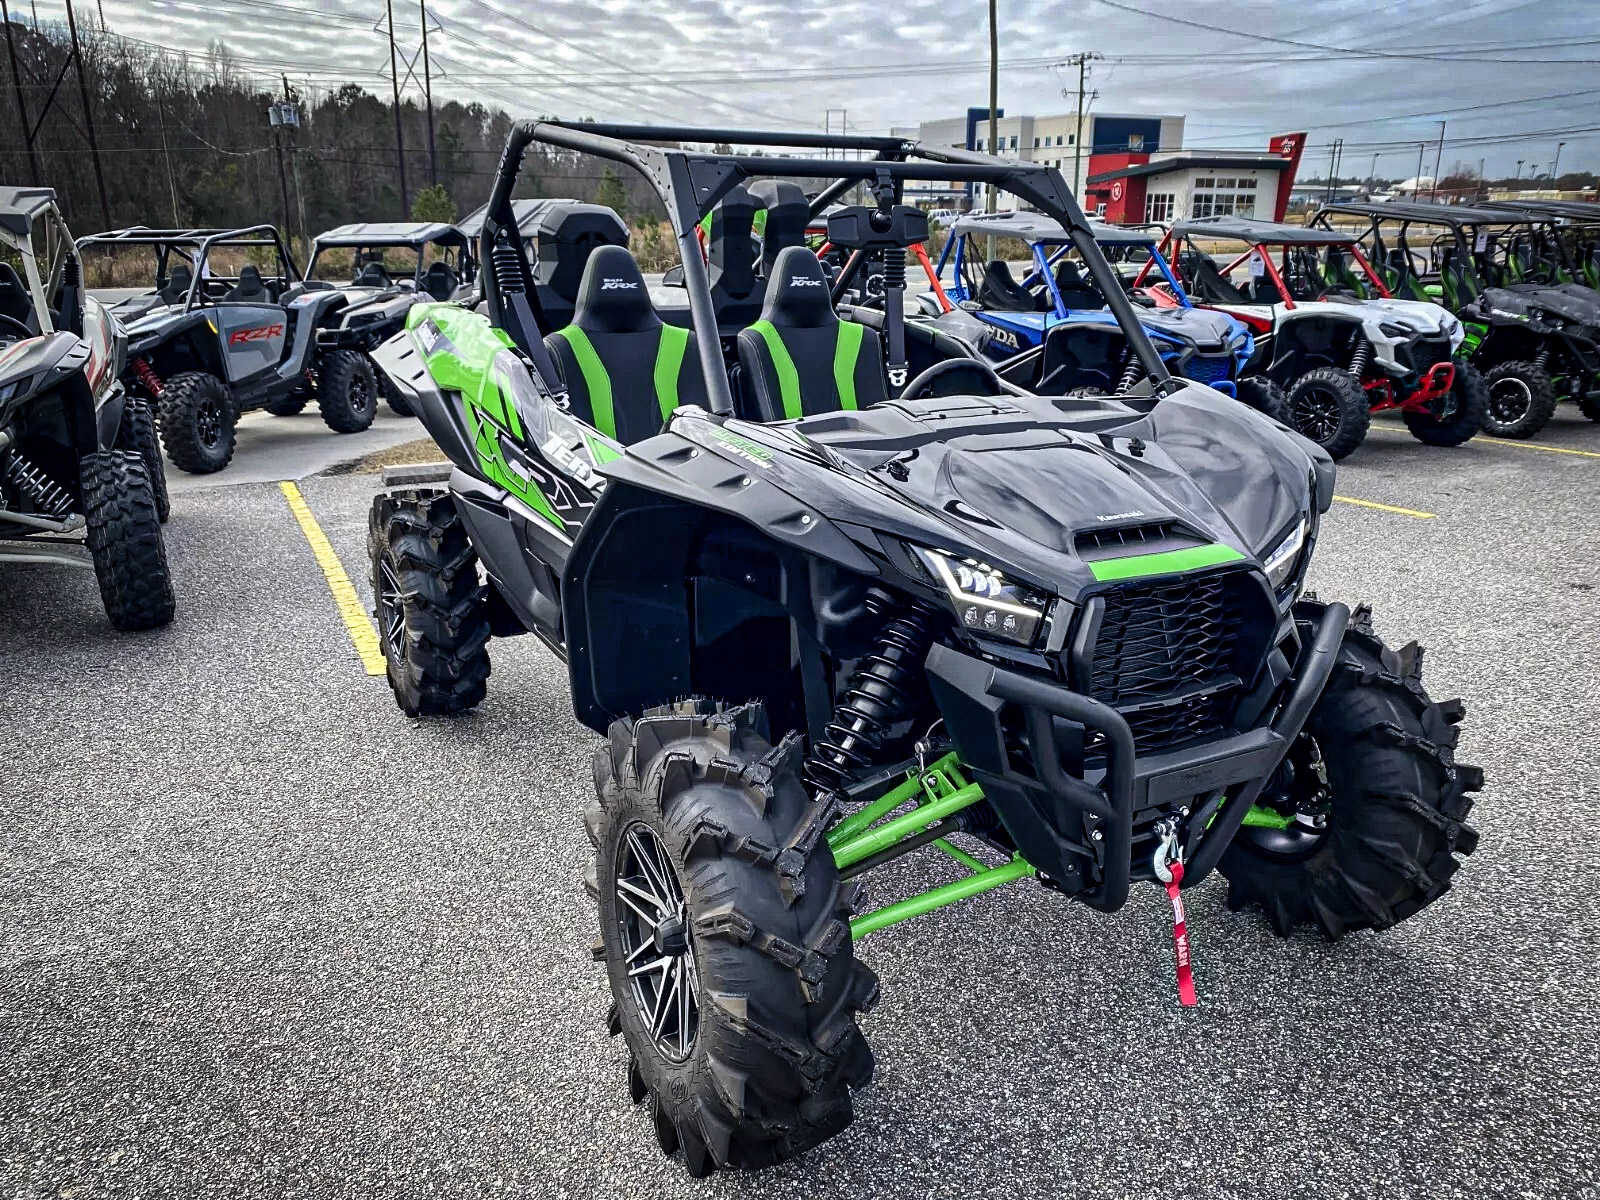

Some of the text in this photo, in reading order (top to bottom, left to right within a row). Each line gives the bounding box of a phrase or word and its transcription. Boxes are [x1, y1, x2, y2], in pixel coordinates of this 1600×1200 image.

[601, 282, 639, 290] KRX
[790, 279, 822, 287] KRX
[229, 322, 284, 346] RZR
[717, 441, 773, 469] EDITION
[1176, 934, 1189, 968] WARN
